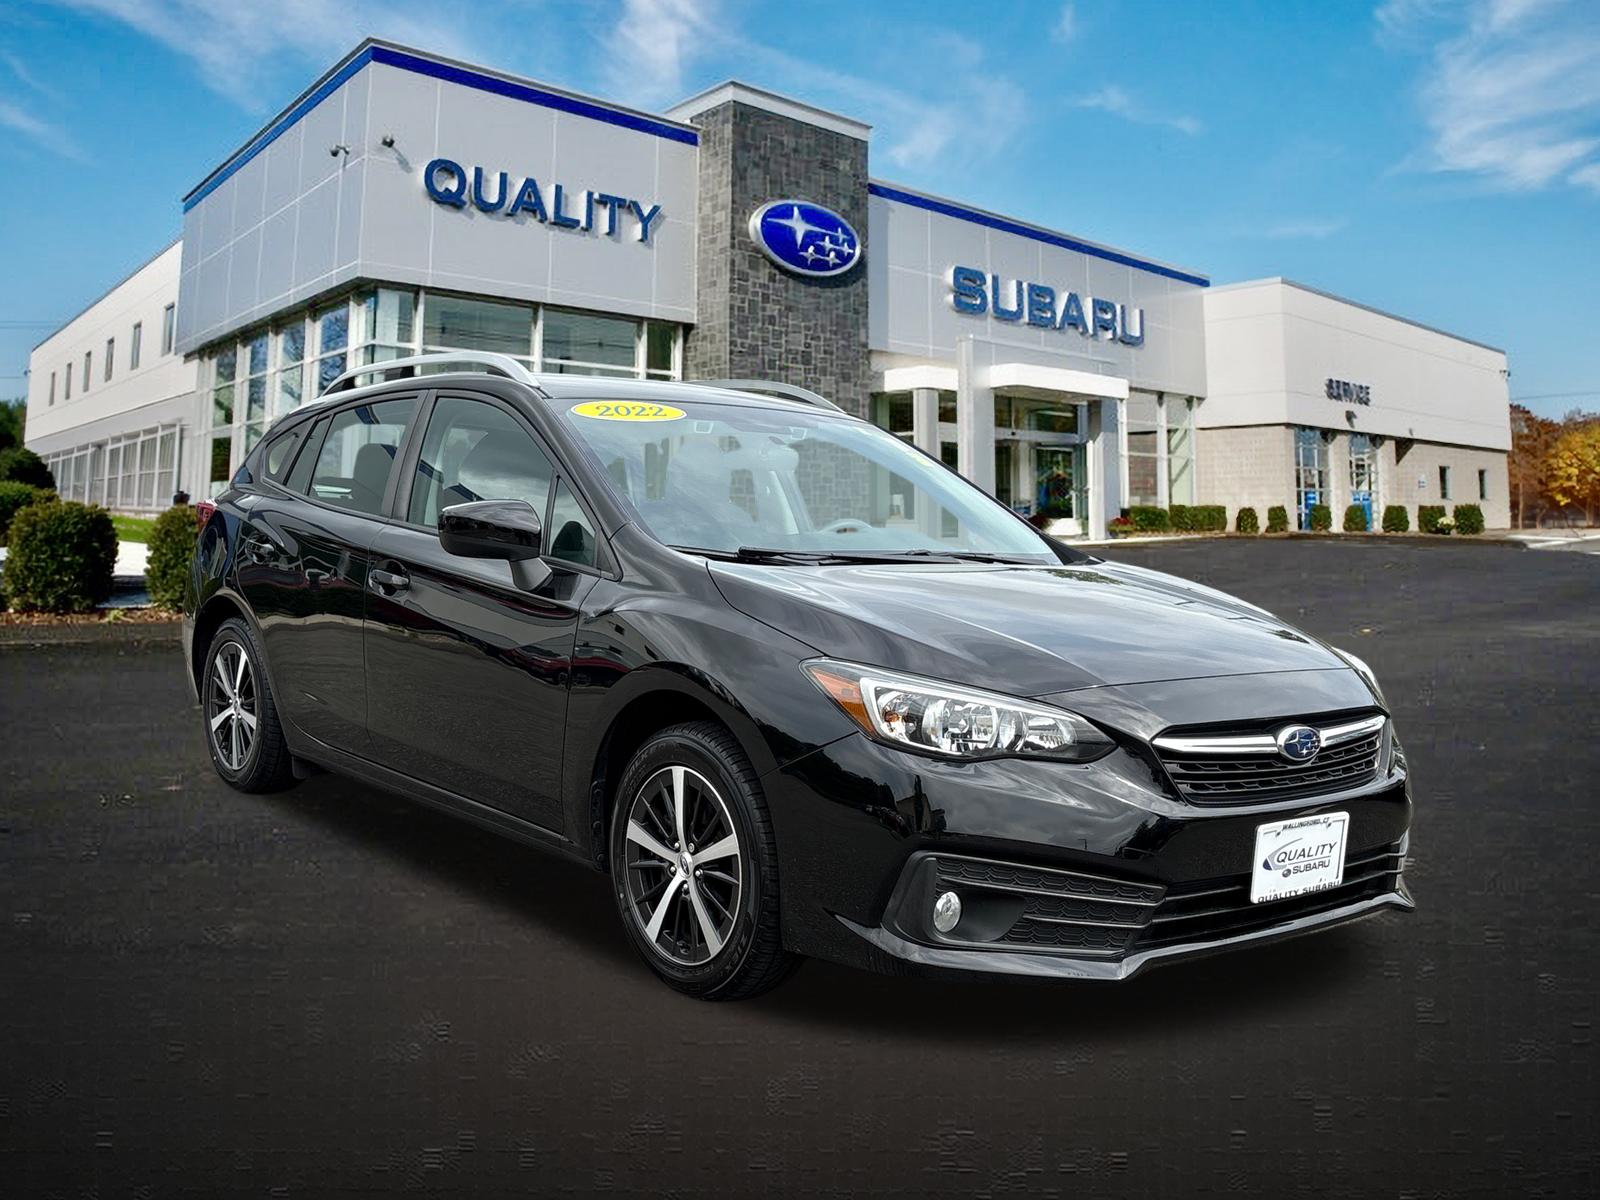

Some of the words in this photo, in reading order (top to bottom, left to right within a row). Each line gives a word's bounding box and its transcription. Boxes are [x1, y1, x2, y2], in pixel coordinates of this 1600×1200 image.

[423, 158, 661, 242] QUALITY
[950, 265, 1144, 346] SUBARU
[1325, 378, 1371, 406] SERVICE
[595, 405, 667, 417] 2022
[1276, 841, 1337, 863] QUALITY
[1292, 860, 1330, 874] SUBARU
[1258, 888, 1300, 903] QUALITY
[1302, 880, 1340, 895] SUBARU
